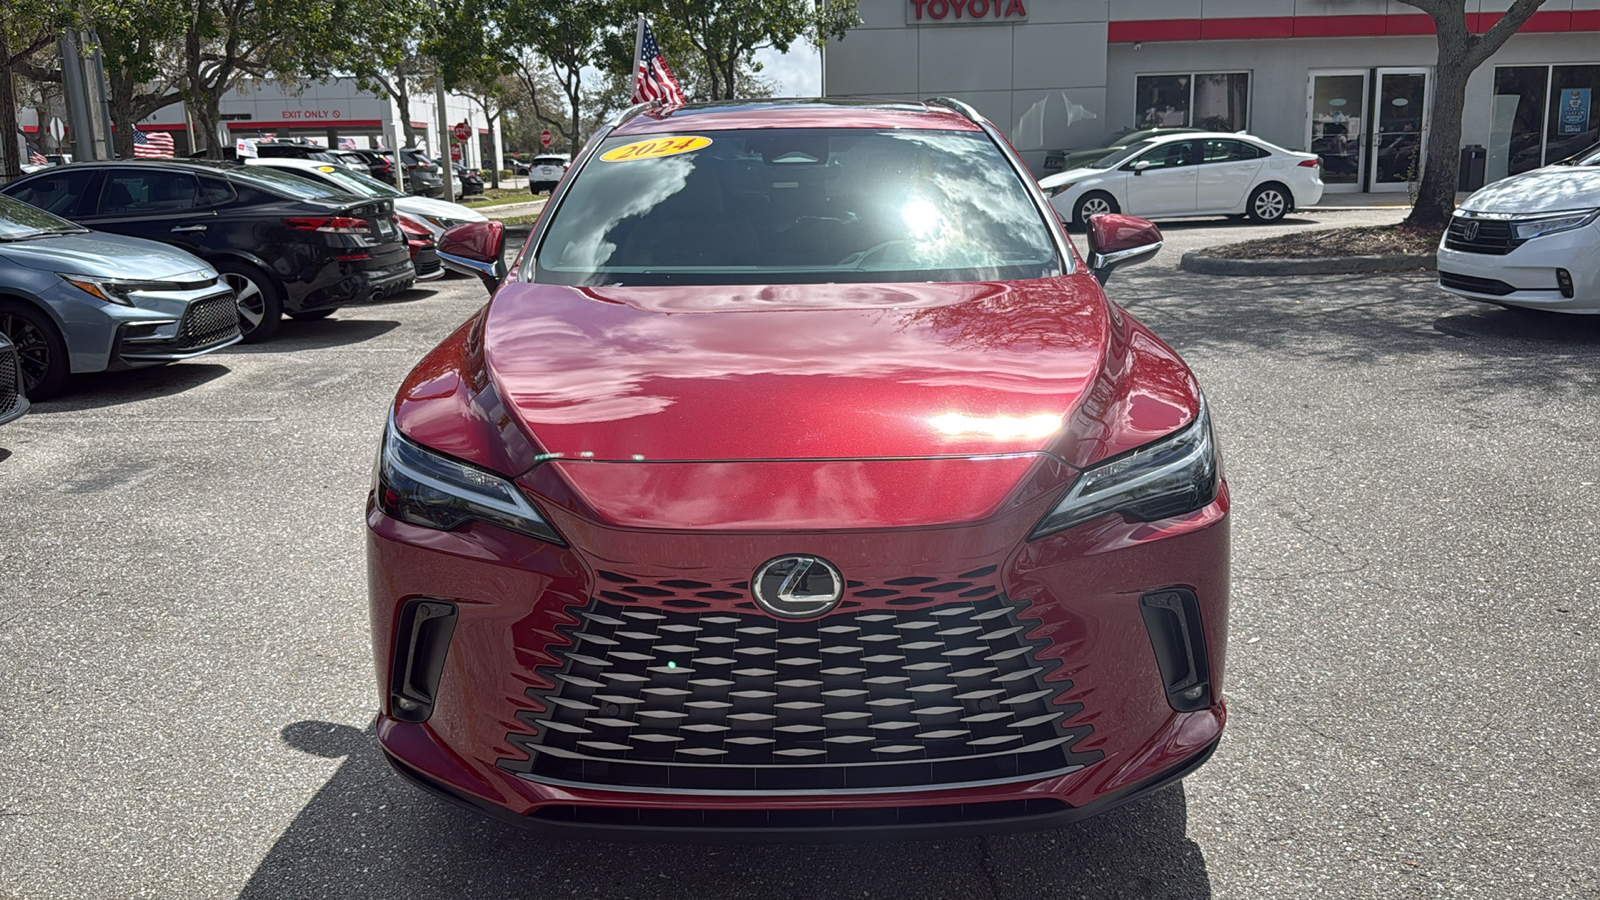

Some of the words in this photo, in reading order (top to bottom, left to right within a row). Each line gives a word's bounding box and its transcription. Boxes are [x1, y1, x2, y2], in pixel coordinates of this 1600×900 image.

[910, 0, 1027, 20] TOYOTA
[282, 110, 302, 120] EXIT
[304, 110, 329, 119] ONLY
[614, 138, 697, 160] 2024
